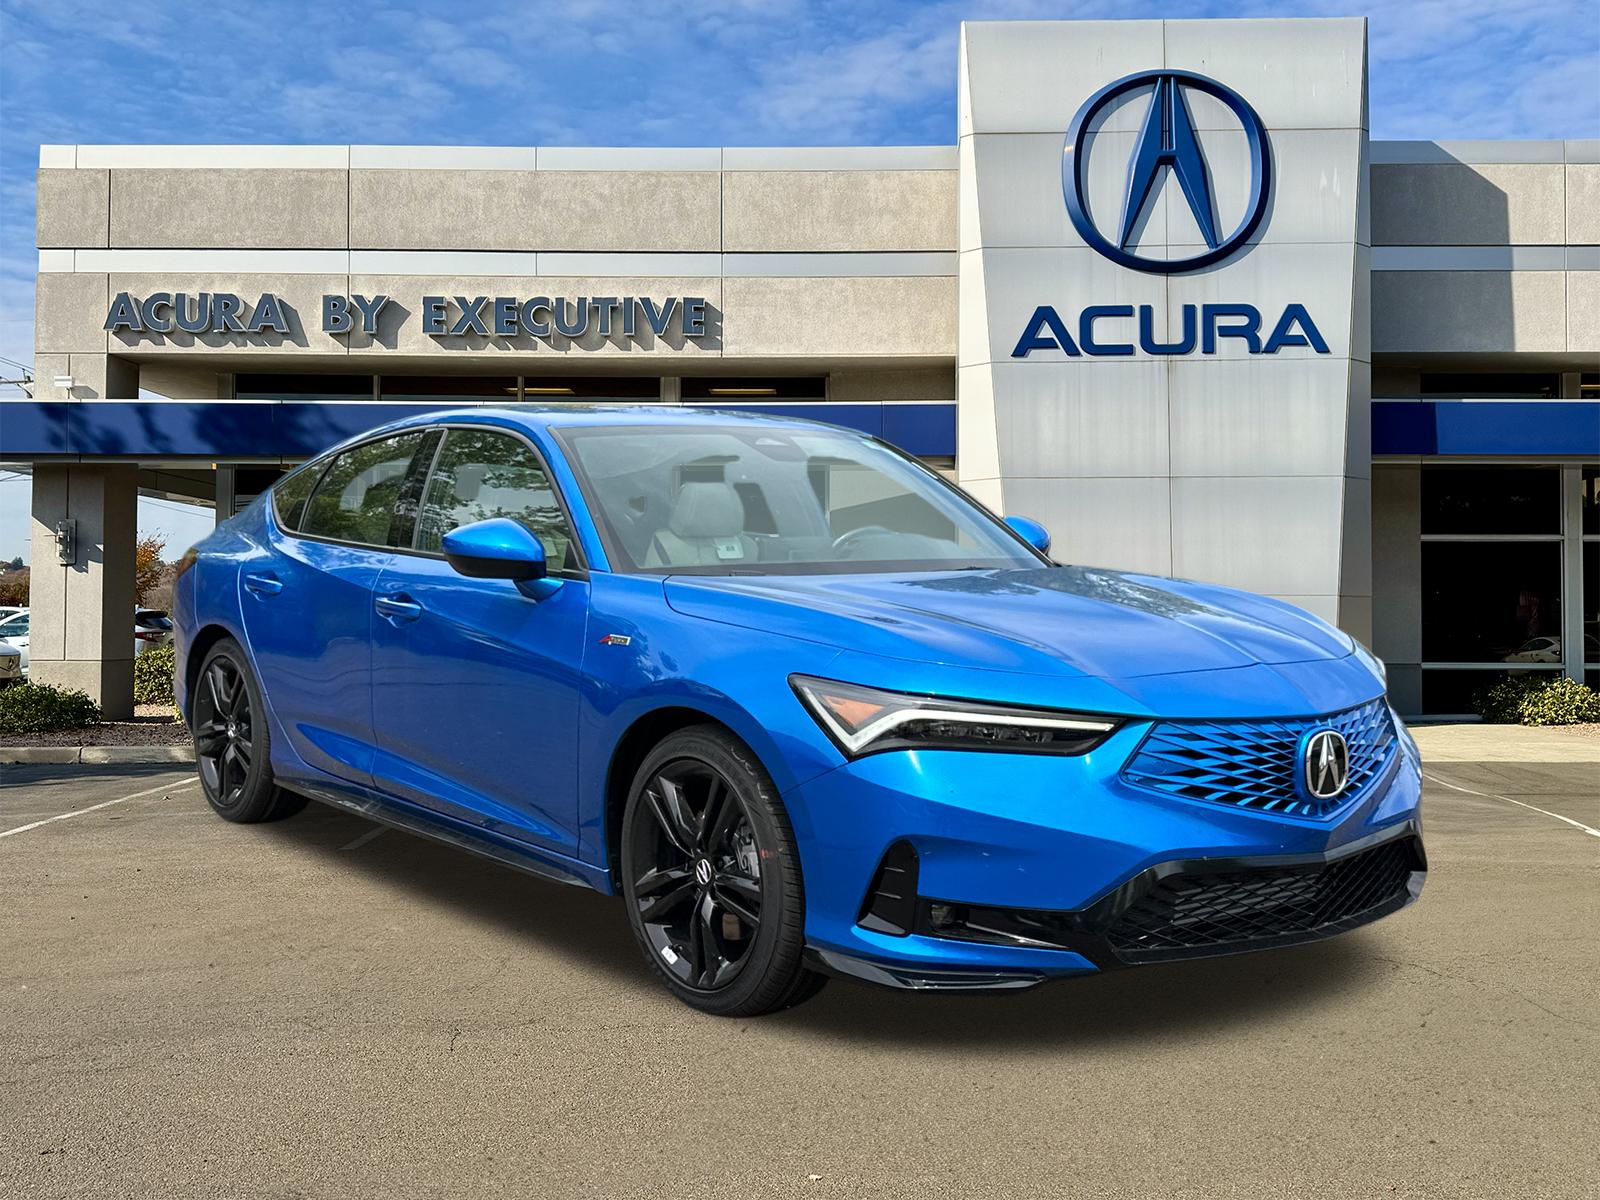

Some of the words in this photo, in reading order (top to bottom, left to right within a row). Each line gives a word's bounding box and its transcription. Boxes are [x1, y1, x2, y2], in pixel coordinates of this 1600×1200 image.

[103, 292, 288, 333] ACURA
[322, 294, 390, 334] BY
[422, 295, 705, 336] EXECUTIVE
[1010, 303, 1332, 357] ACURA
